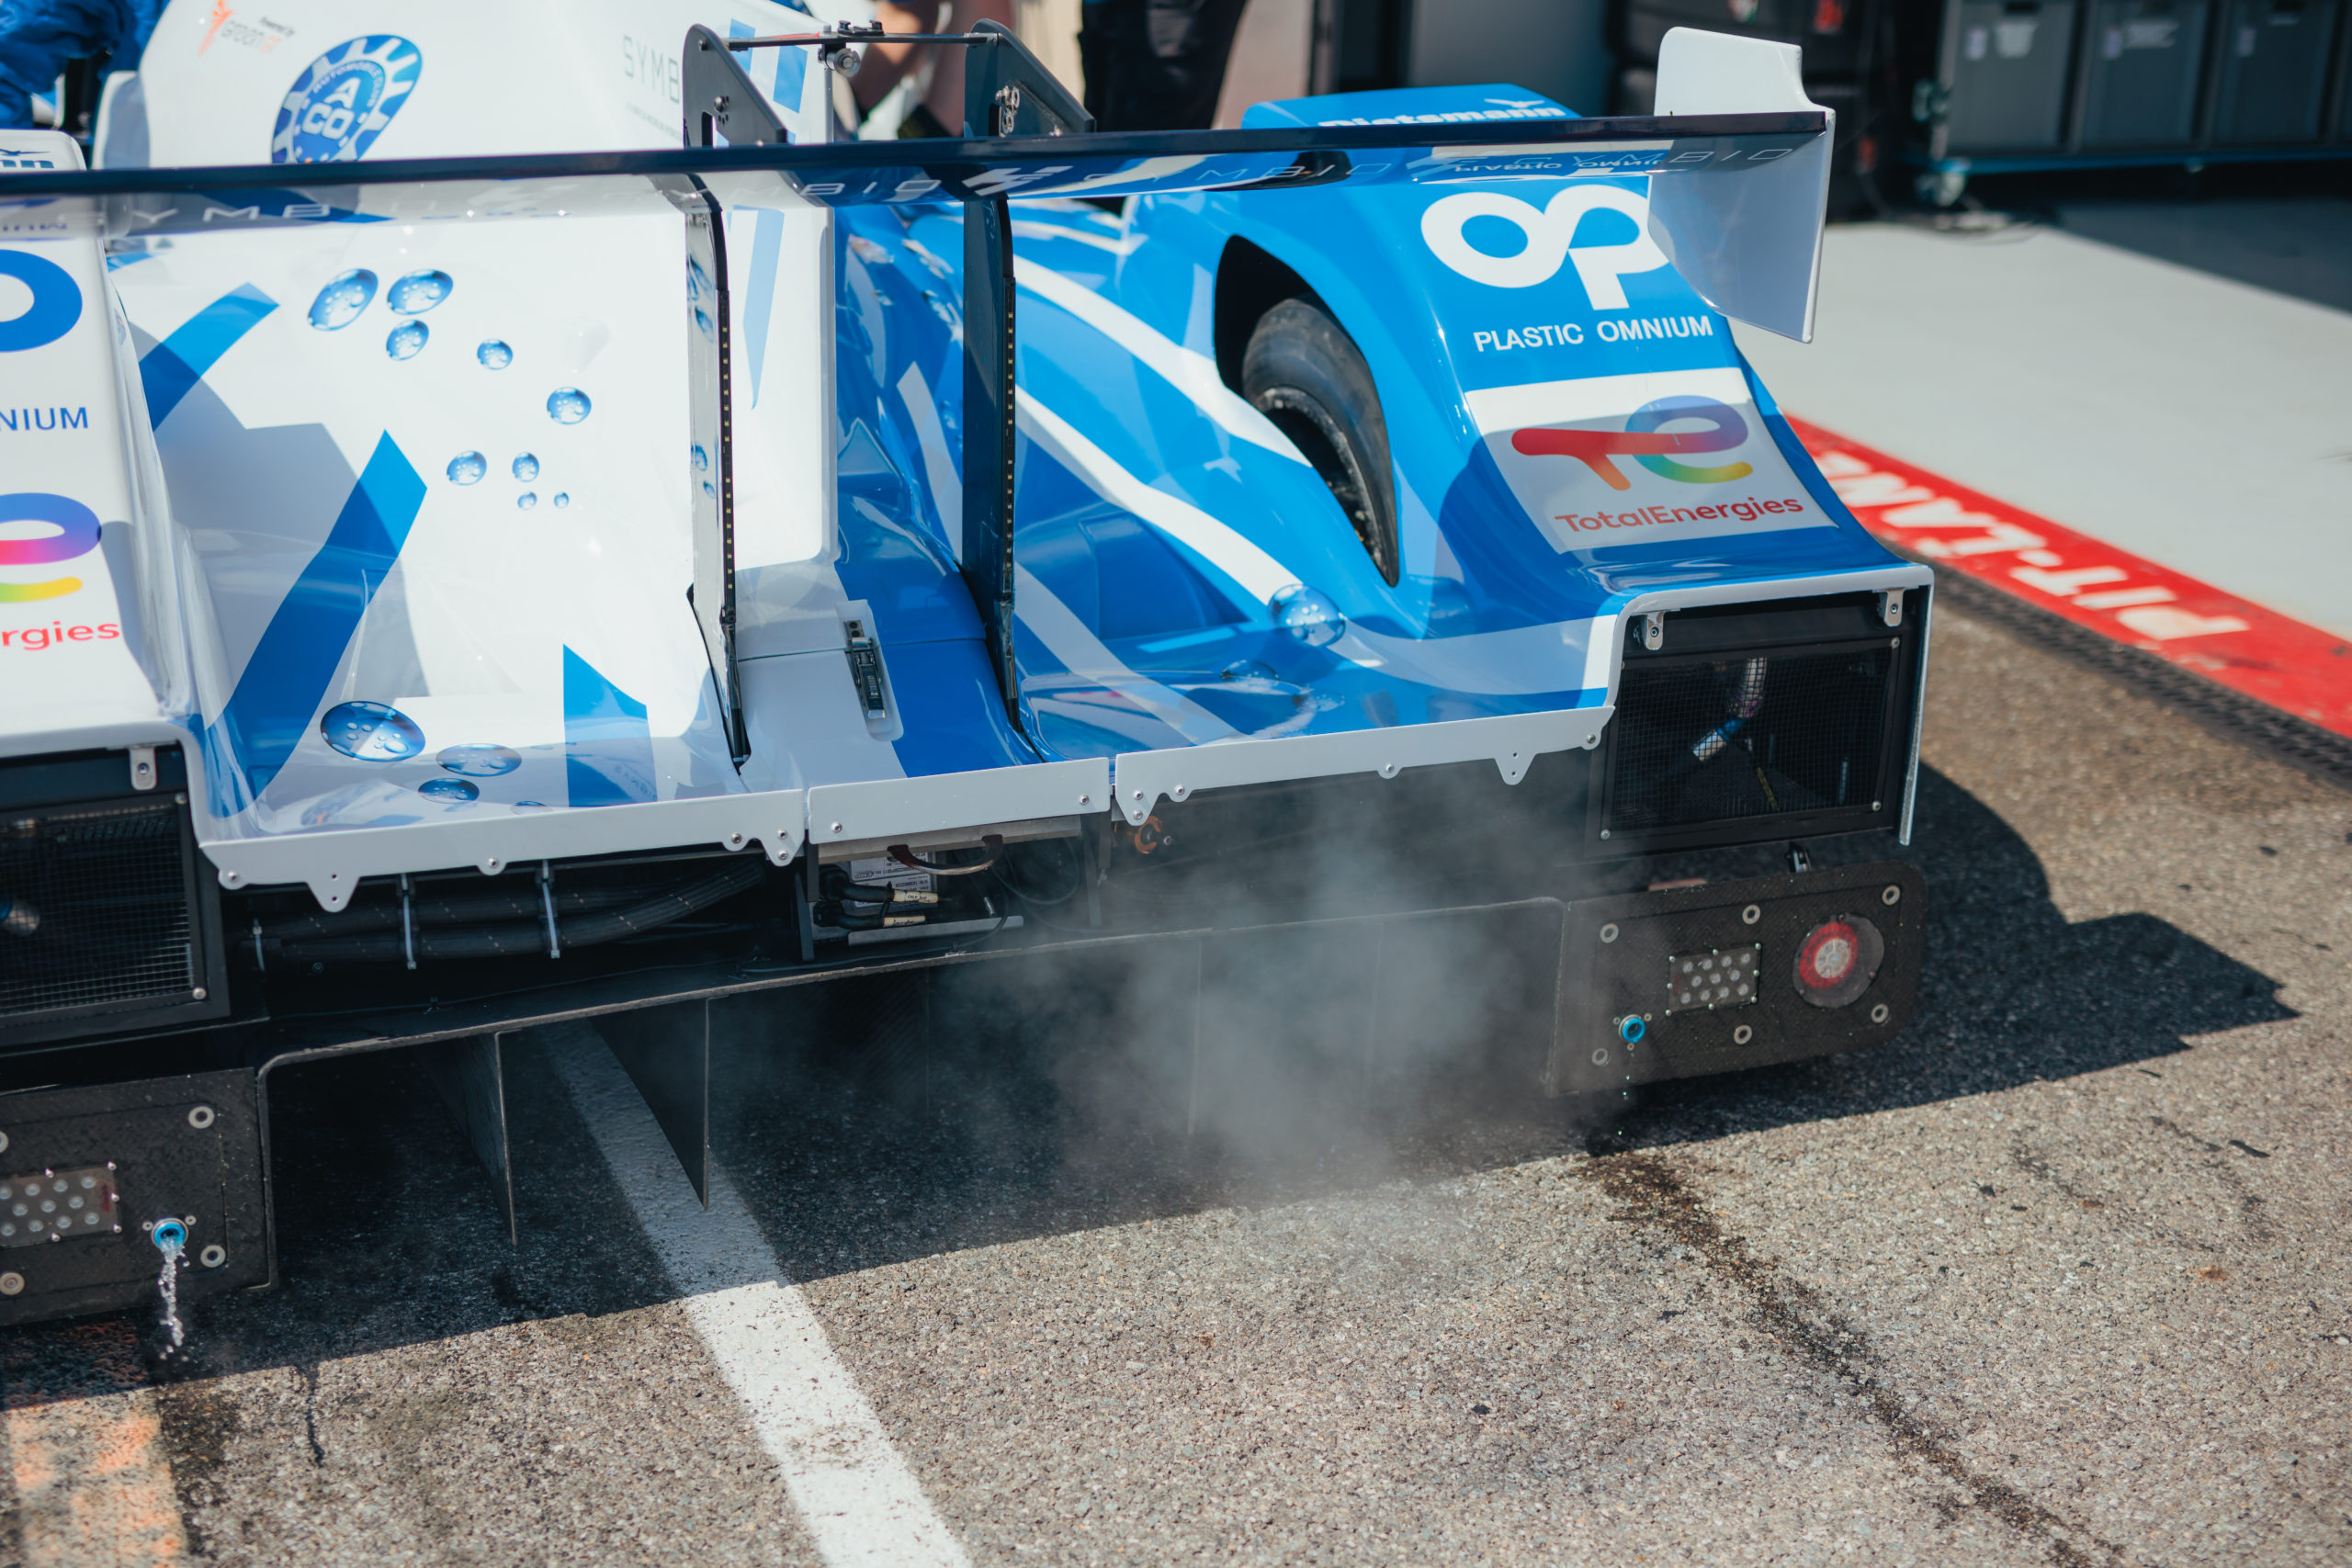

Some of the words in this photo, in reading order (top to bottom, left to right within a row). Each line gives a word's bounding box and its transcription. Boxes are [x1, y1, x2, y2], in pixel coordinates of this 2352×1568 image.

[1473, 323, 1584, 353] PLASTIC
[1596, 315, 1714, 343] OMNIUM
[1555, 497, 1804, 533] TotalEnergies
